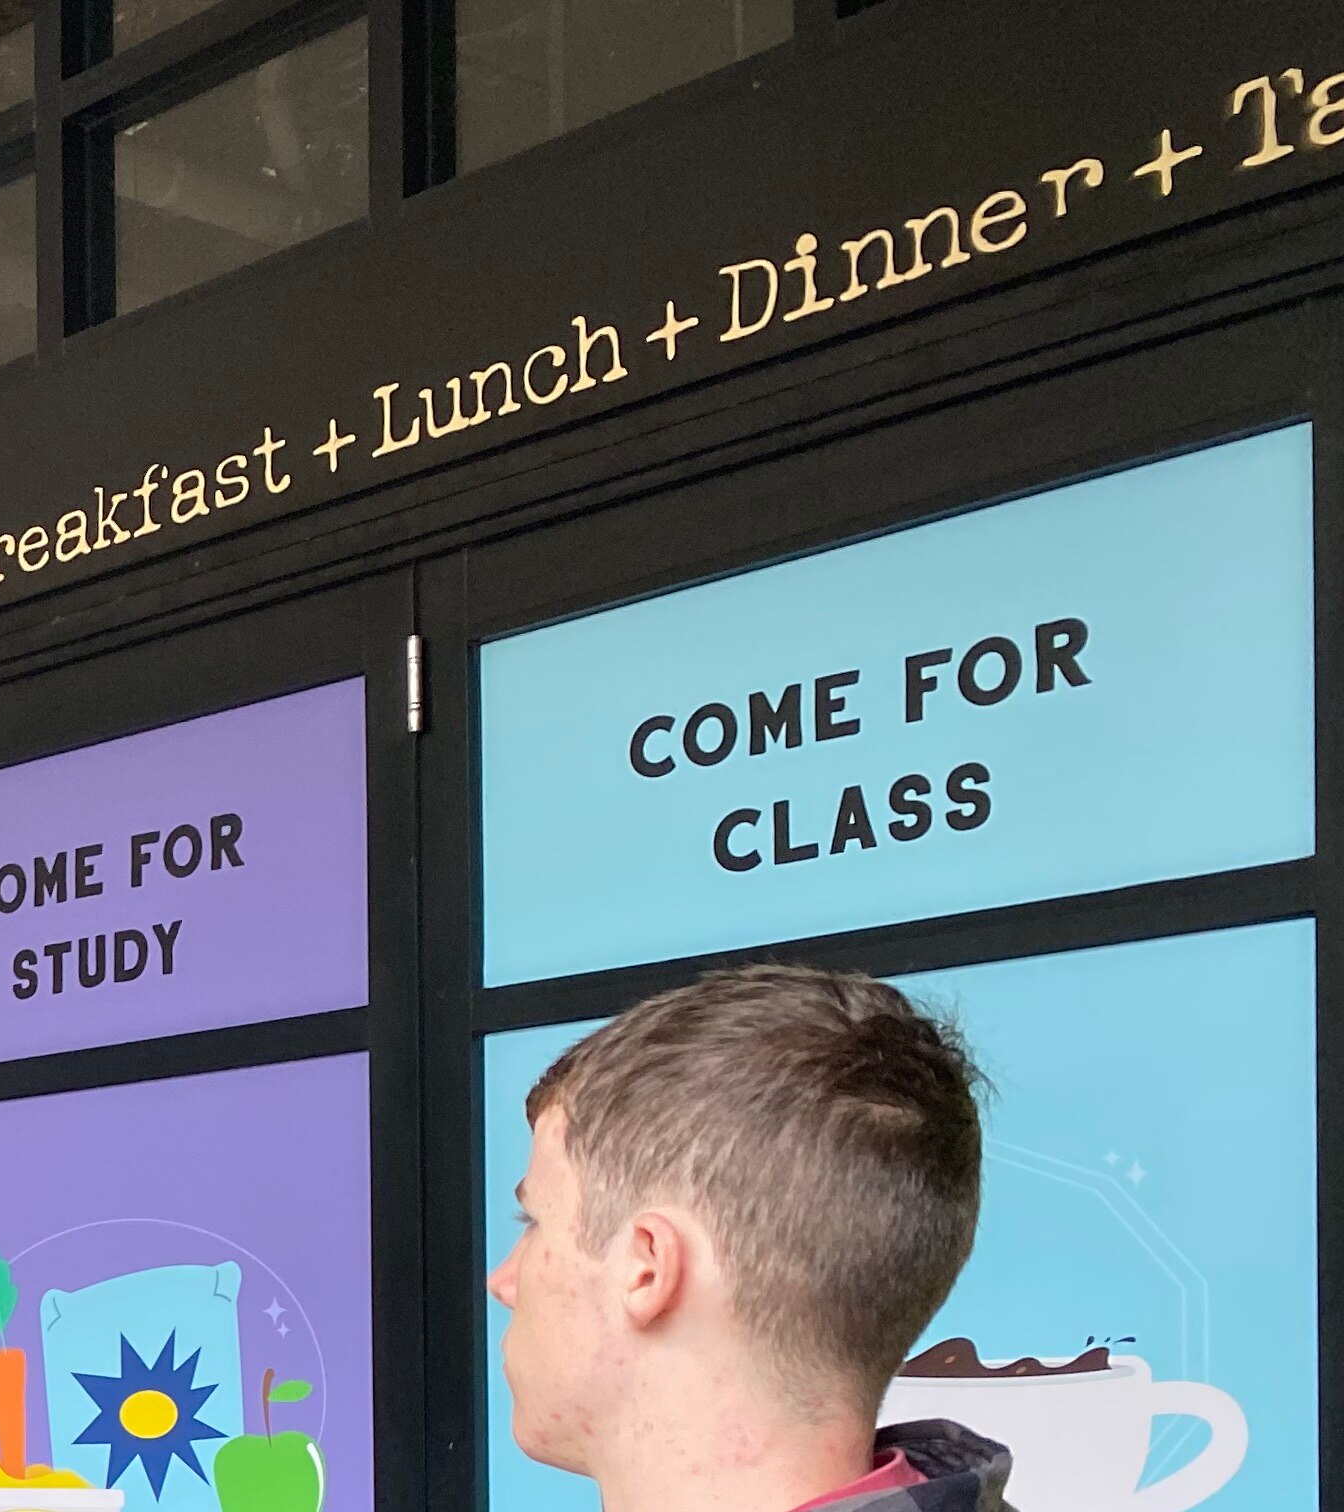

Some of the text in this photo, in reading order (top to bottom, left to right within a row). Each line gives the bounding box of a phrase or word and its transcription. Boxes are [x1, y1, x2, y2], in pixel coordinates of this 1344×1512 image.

[371, 315, 630, 458] Lunch
[717, 157, 1105, 343] Dinner
[628, 617, 1092, 779] COME FOR
[130, 812, 246, 889] FOR
[712, 761, 992, 873] CLASS
[12, 919, 184, 1000] STUDY
